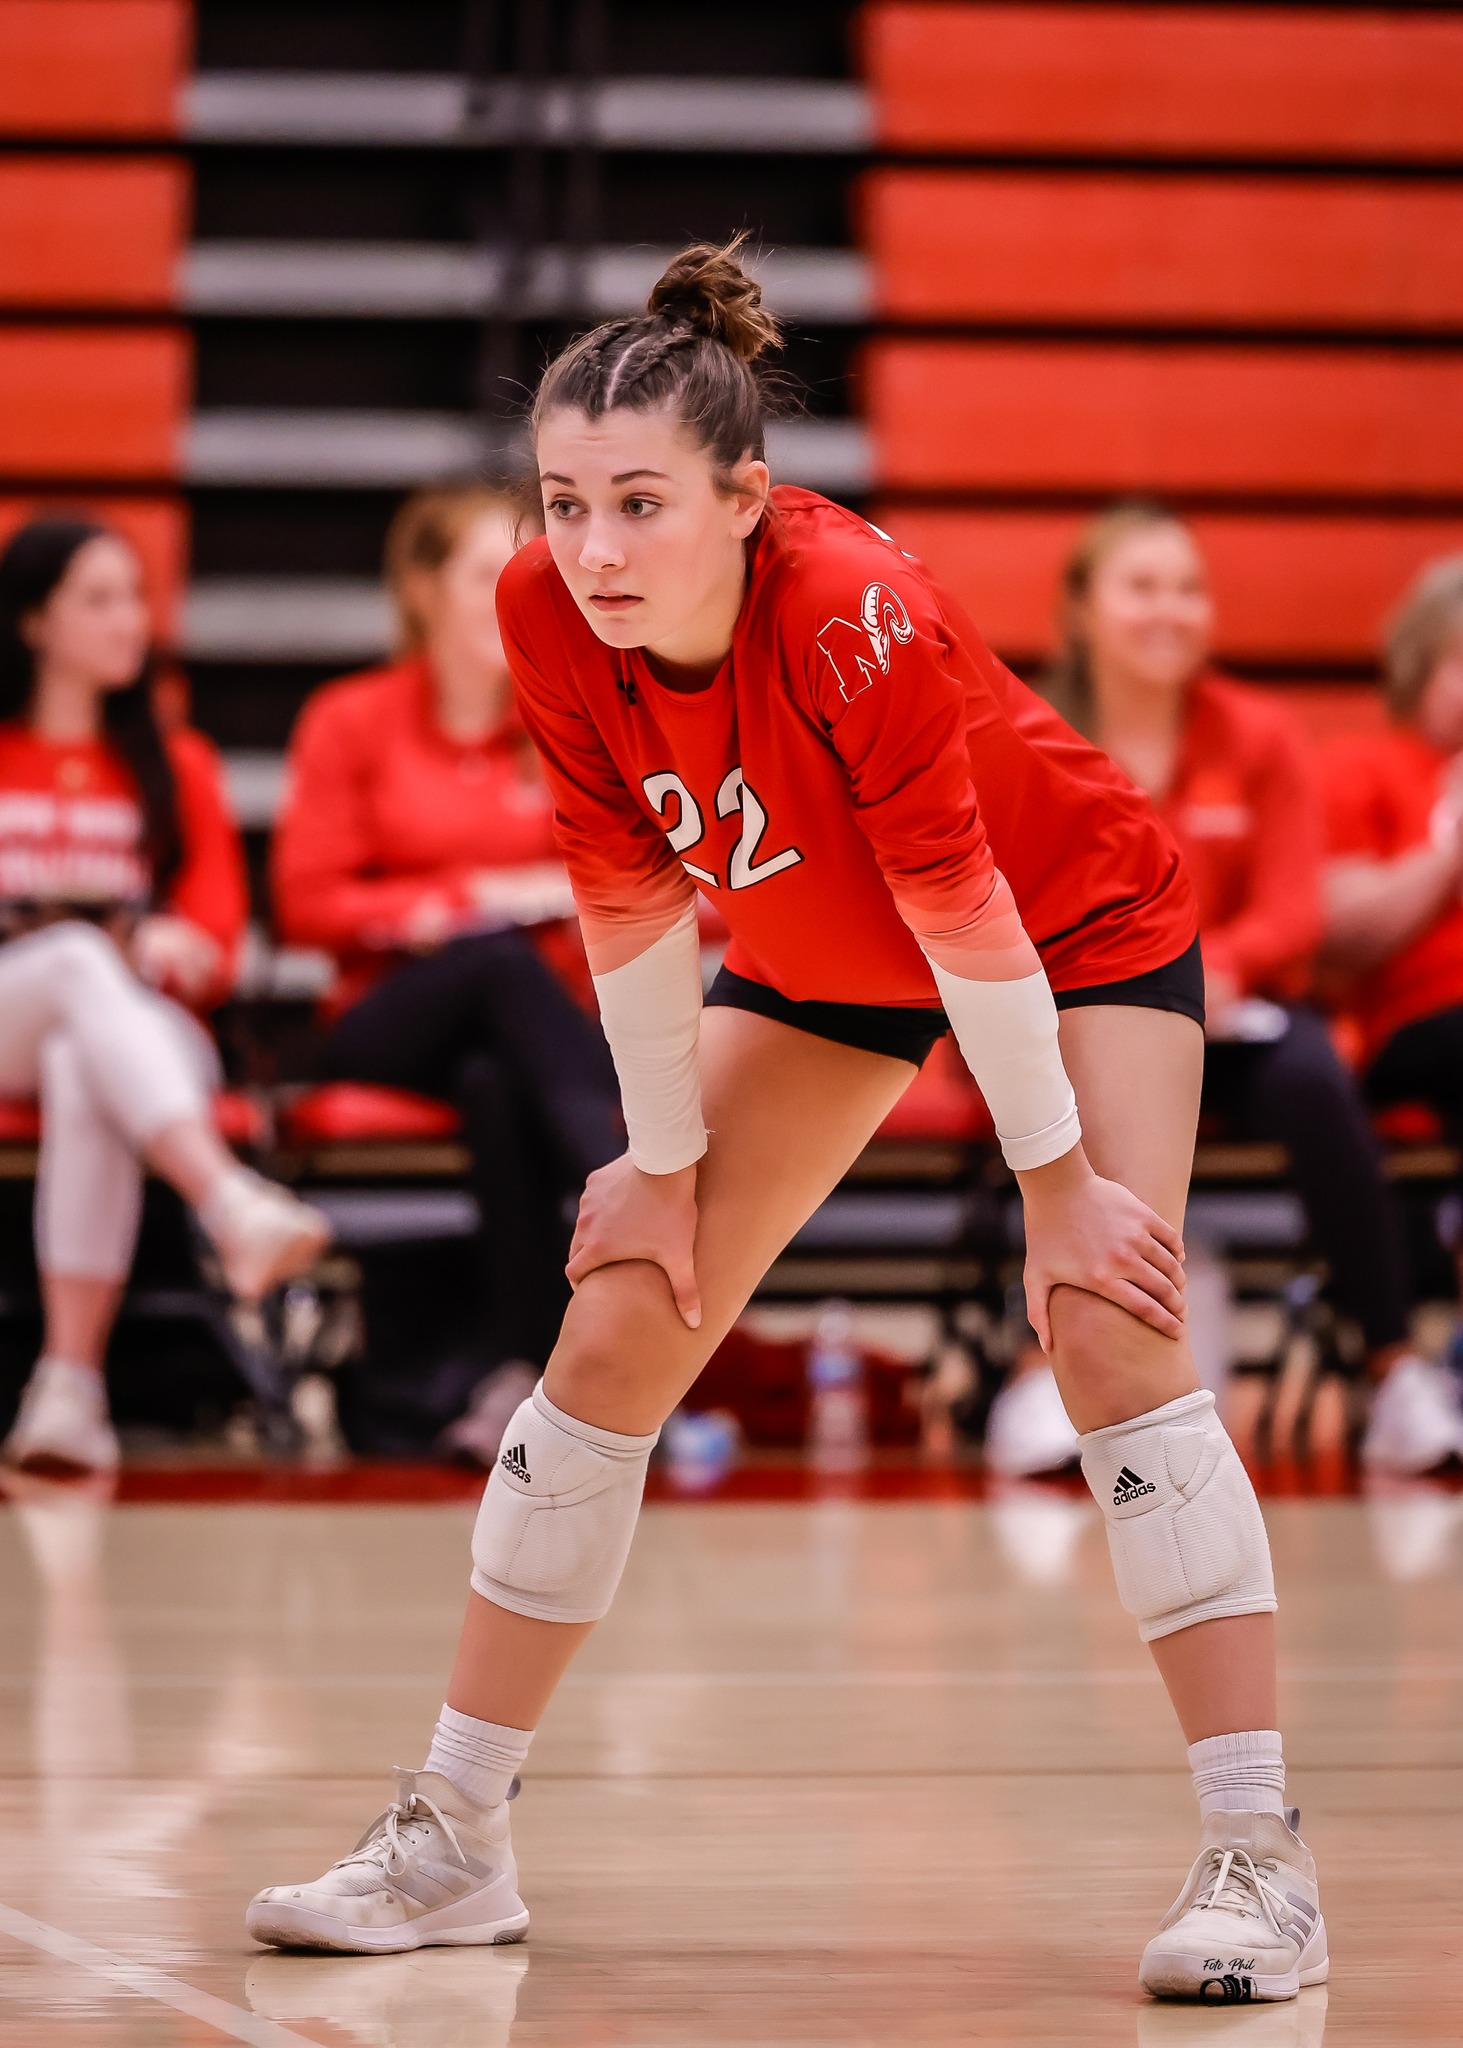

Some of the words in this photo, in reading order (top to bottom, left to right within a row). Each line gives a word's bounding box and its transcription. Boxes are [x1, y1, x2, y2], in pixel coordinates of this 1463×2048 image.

[641, 764, 806, 890] 22
[501, 1455, 532, 1484] adidas
[1113, 1482, 1157, 1506] adidas
